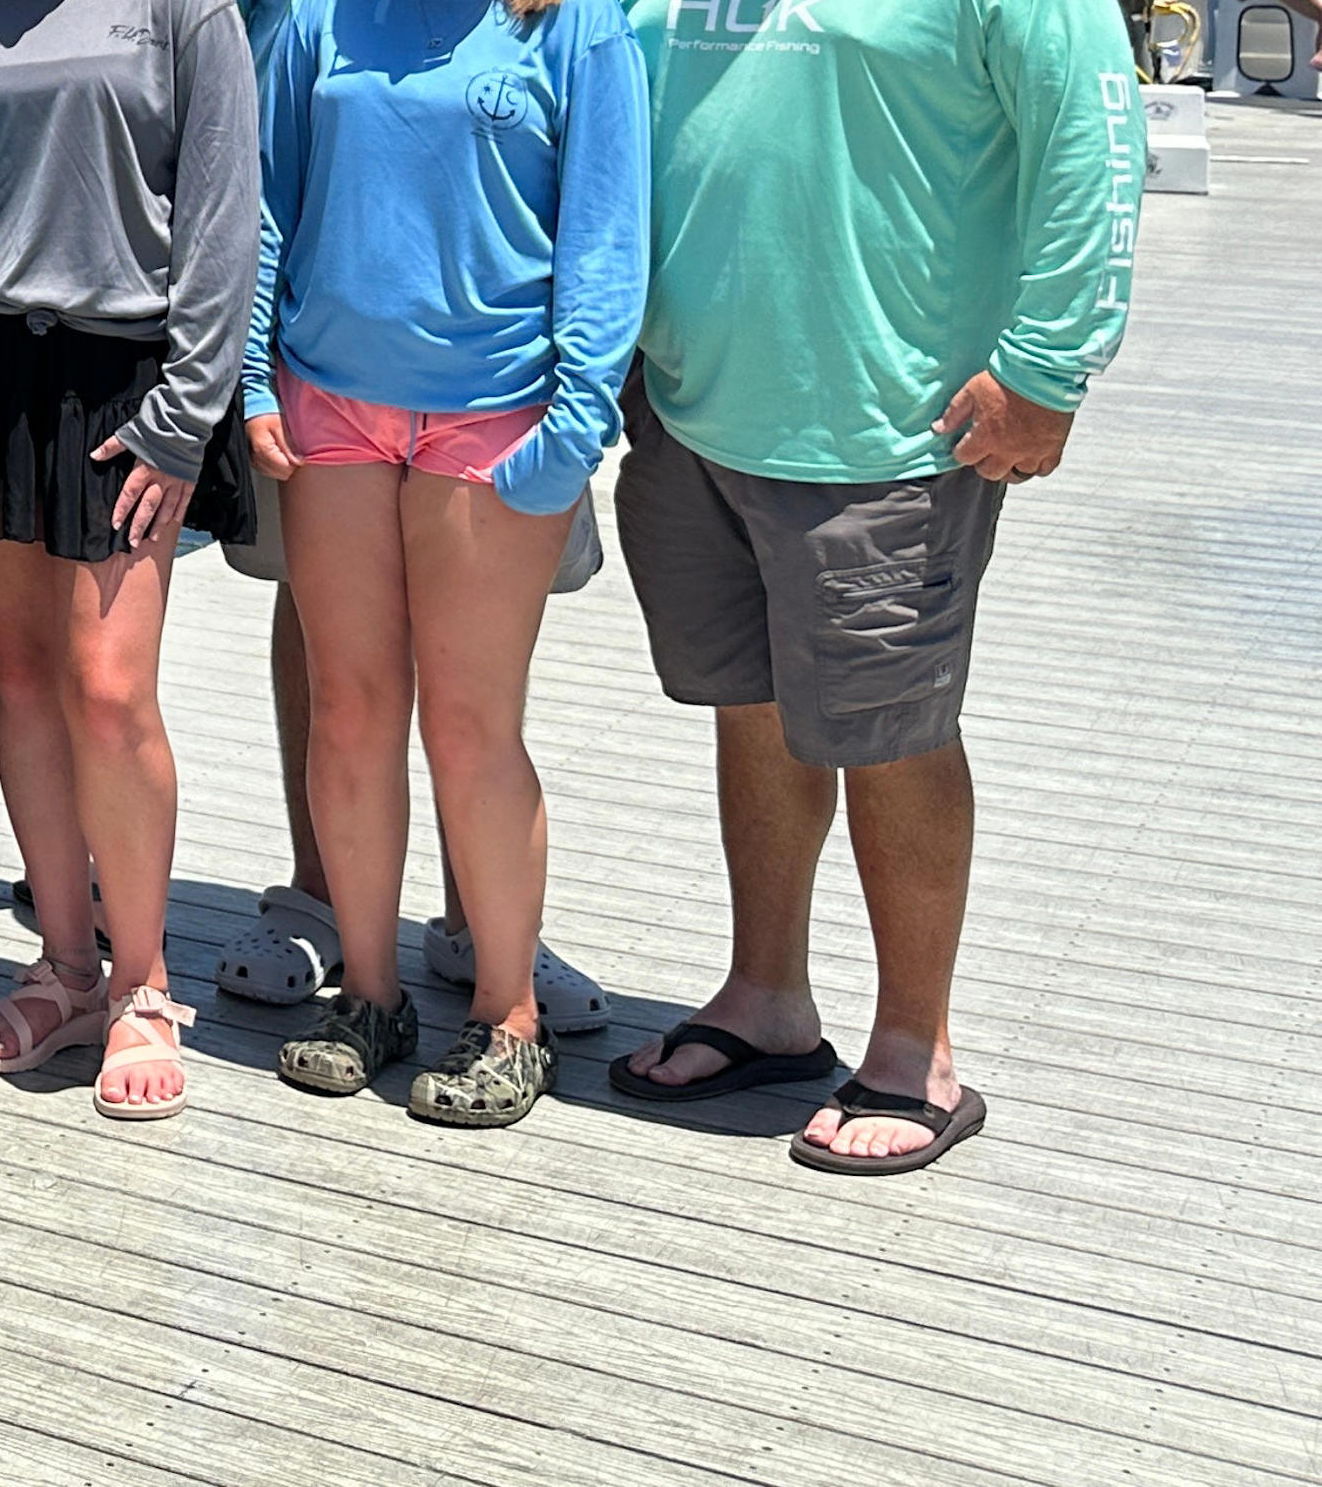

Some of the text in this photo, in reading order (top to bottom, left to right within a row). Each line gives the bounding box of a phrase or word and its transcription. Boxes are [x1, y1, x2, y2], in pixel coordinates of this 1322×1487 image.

[669, 38, 821, 56] Performance Fishing
[1096, 72, 1134, 311] Fishing
